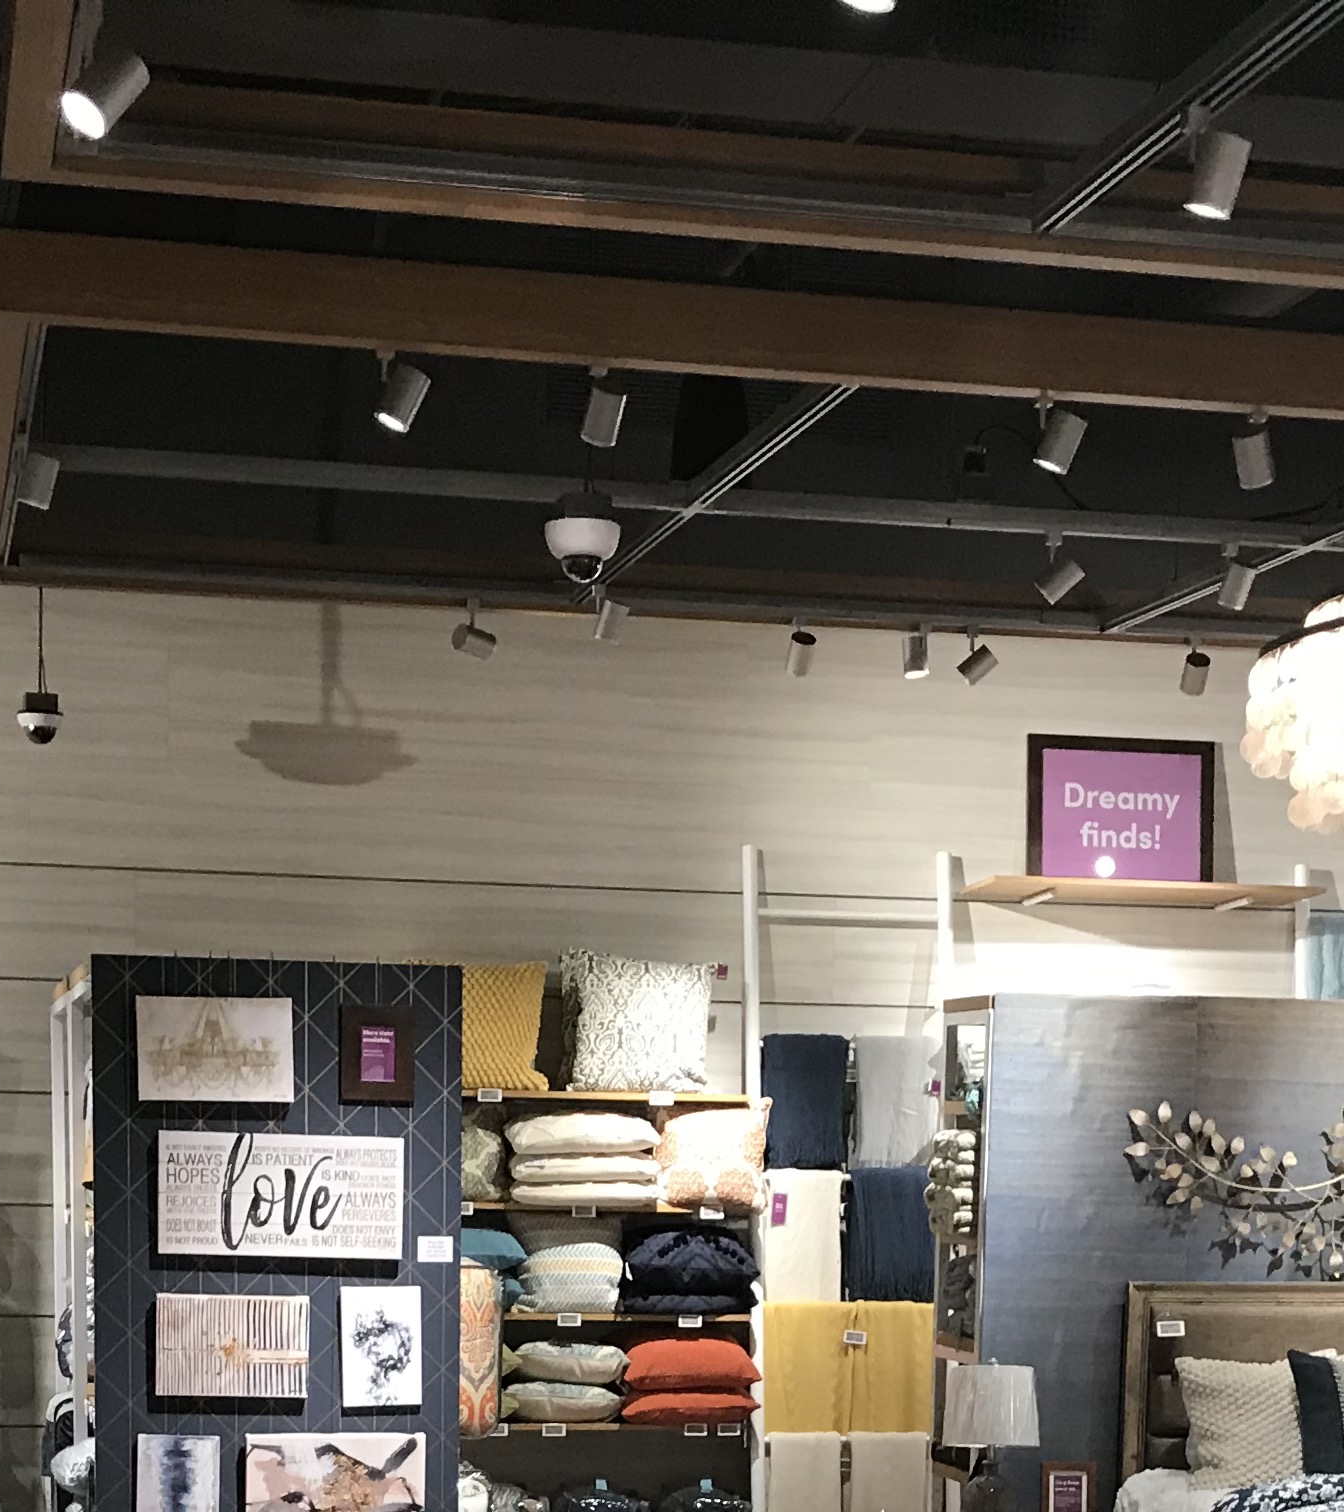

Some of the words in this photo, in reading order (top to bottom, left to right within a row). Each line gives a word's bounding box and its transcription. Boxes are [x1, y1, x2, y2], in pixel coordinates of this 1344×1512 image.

[1064, 782, 1180, 819] Dreamy
[1080, 821, 1162, 850] finds!
[167, 1152, 223, 1166] ALWAYS
[253, 1154, 263, 1165] IS
[265, 1154, 314, 1166] PATIENT
[166, 1168, 221, 1185] HOPES
[321, 1170, 331, 1181] IS
[334, 1170, 360, 1181] KIND
[221, 1132, 343, 1250] love
[166, 1195, 216, 1207] REJOICES
[344, 1192, 396, 1208] ALWAYS
[342, 1209, 396, 1222] PERSEVERES
[332, 1225, 355, 1234] DOES
[356, 1226, 373, 1235] NOT
[375, 1226, 396, 1236] ENVY
[174, 1236, 190, 1245] NOT
[192, 1236, 218, 1245] PROUD
[245, 1233, 283, 1245] NEVER
[312, 1236, 319, 1247] IS
[321, 1236, 338, 1247] NOT
[340, 1235, 396, 1248] SELF-SEEKING
